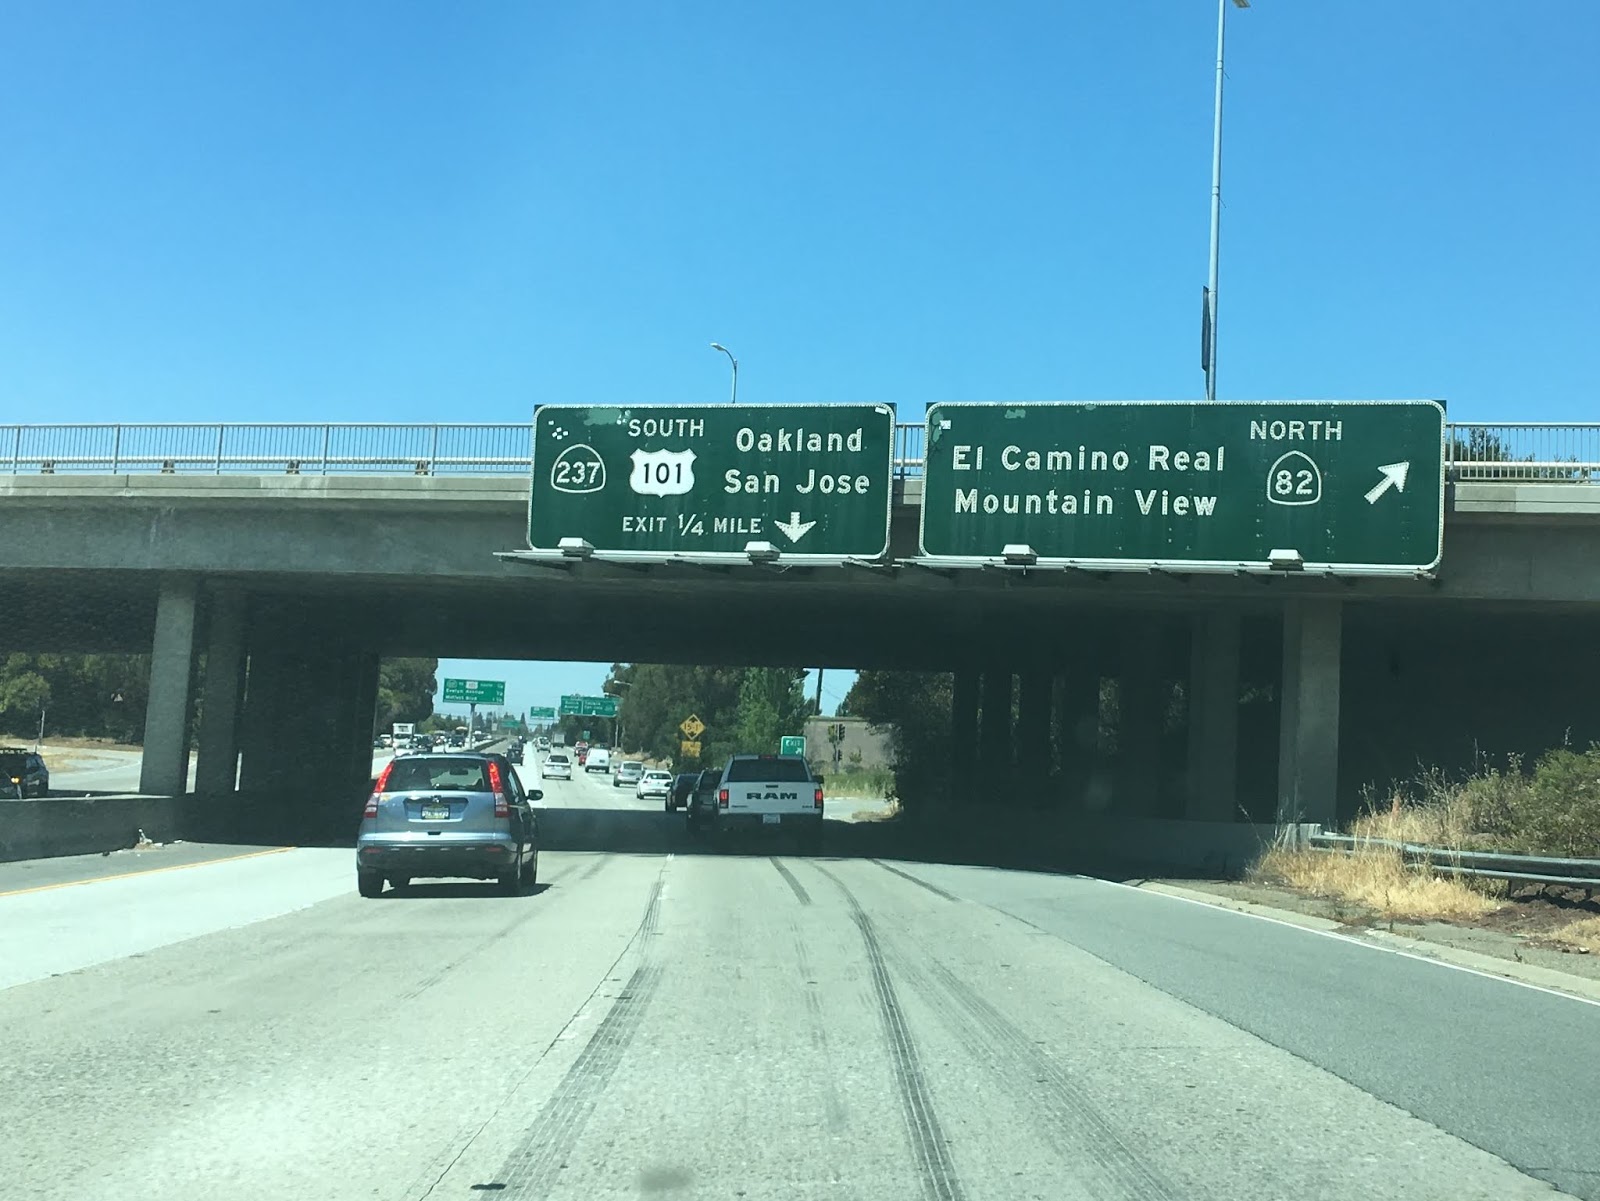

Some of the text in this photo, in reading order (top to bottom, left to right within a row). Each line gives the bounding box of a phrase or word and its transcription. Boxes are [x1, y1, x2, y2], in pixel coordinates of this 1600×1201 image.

[627, 419, 705, 438] SOUTH
[735, 427, 863, 452] Oakland
[1249, 420, 1343, 441] NORTH
[952, 445, 1225, 472] El Camino Real
[555, 461, 602, 484] 237
[643, 462, 683, 485] 101
[724, 469, 871, 495] San Jose
[1275, 469, 1314, 496] 82
[954, 488, 1218, 517] Mountain View
[622, 516, 668, 533] EXIT
[713, 516, 762, 534] MILE
[746, 792, 798, 800] RAM
